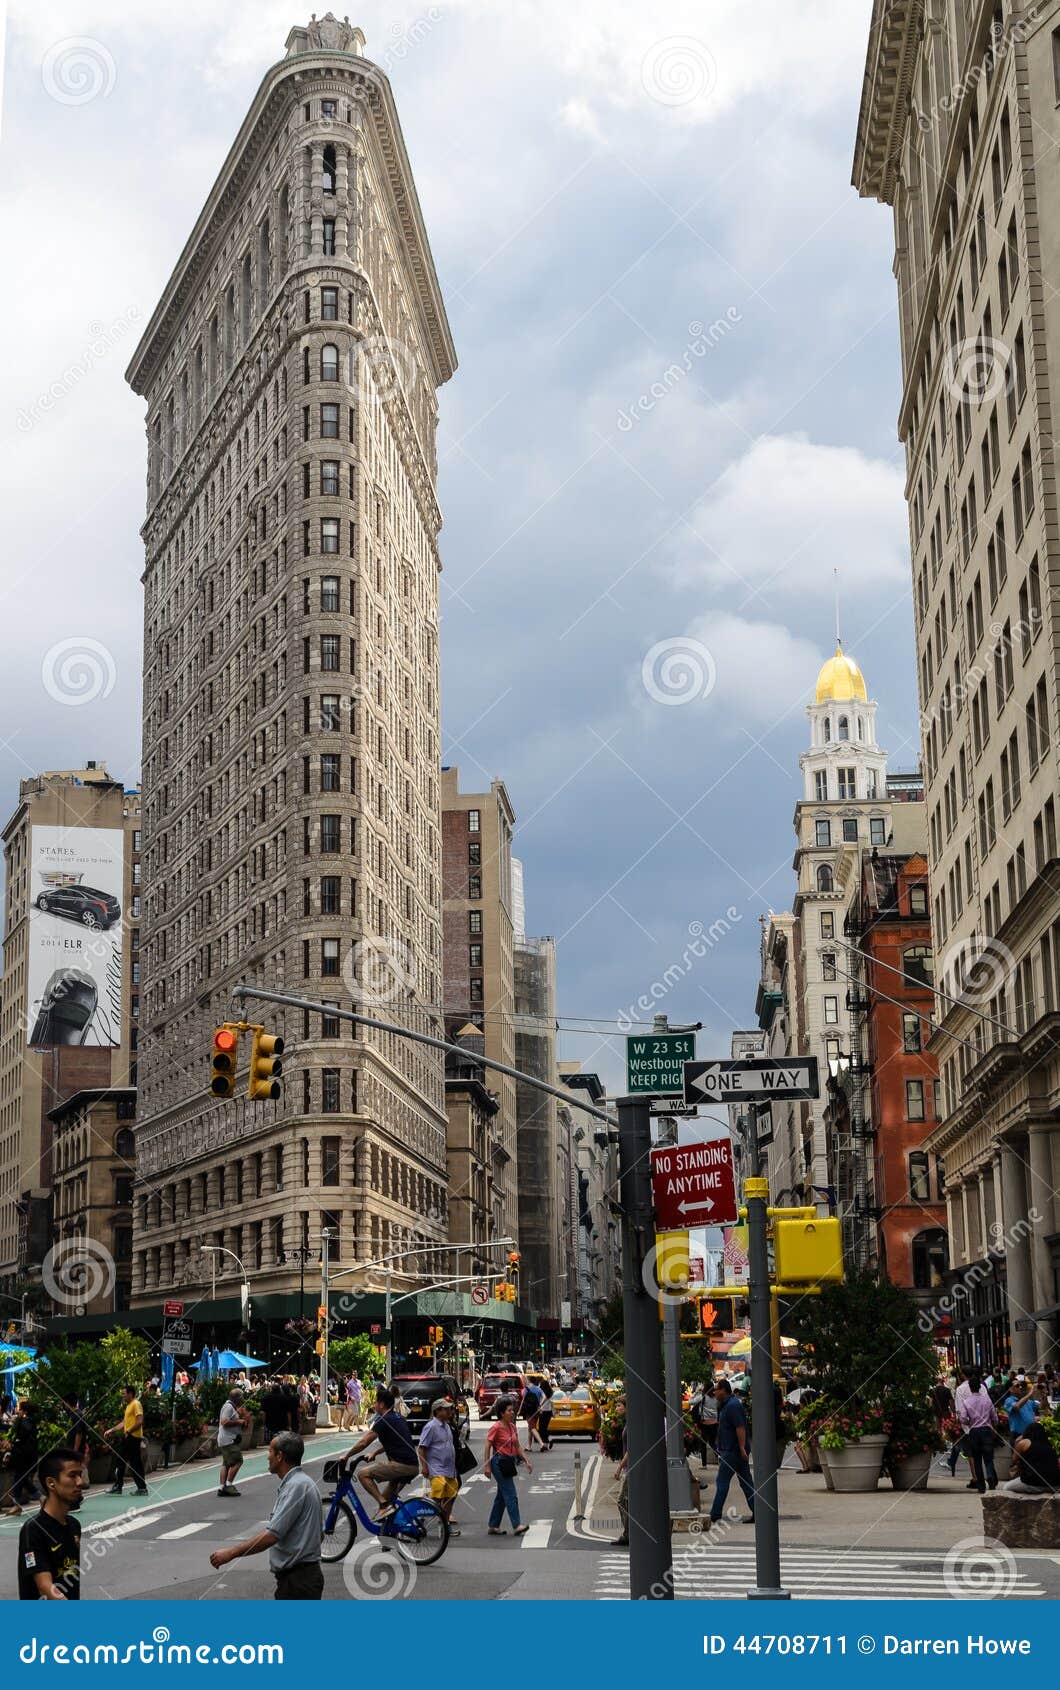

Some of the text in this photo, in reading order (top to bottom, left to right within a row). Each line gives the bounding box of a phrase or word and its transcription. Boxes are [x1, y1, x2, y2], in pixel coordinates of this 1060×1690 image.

[64, 940, 82, 948] ELR
[633, 1041, 689, 1054] W 23 St
[631, 1073, 683, 1086] KEEP RIG
[705, 1070, 800, 1090] ONE WAY
[669, 1100, 688, 1110] WA
[656, 1146, 728, 1174] NO STANDING
[667, 1171, 722, 1195] ANYTIME
